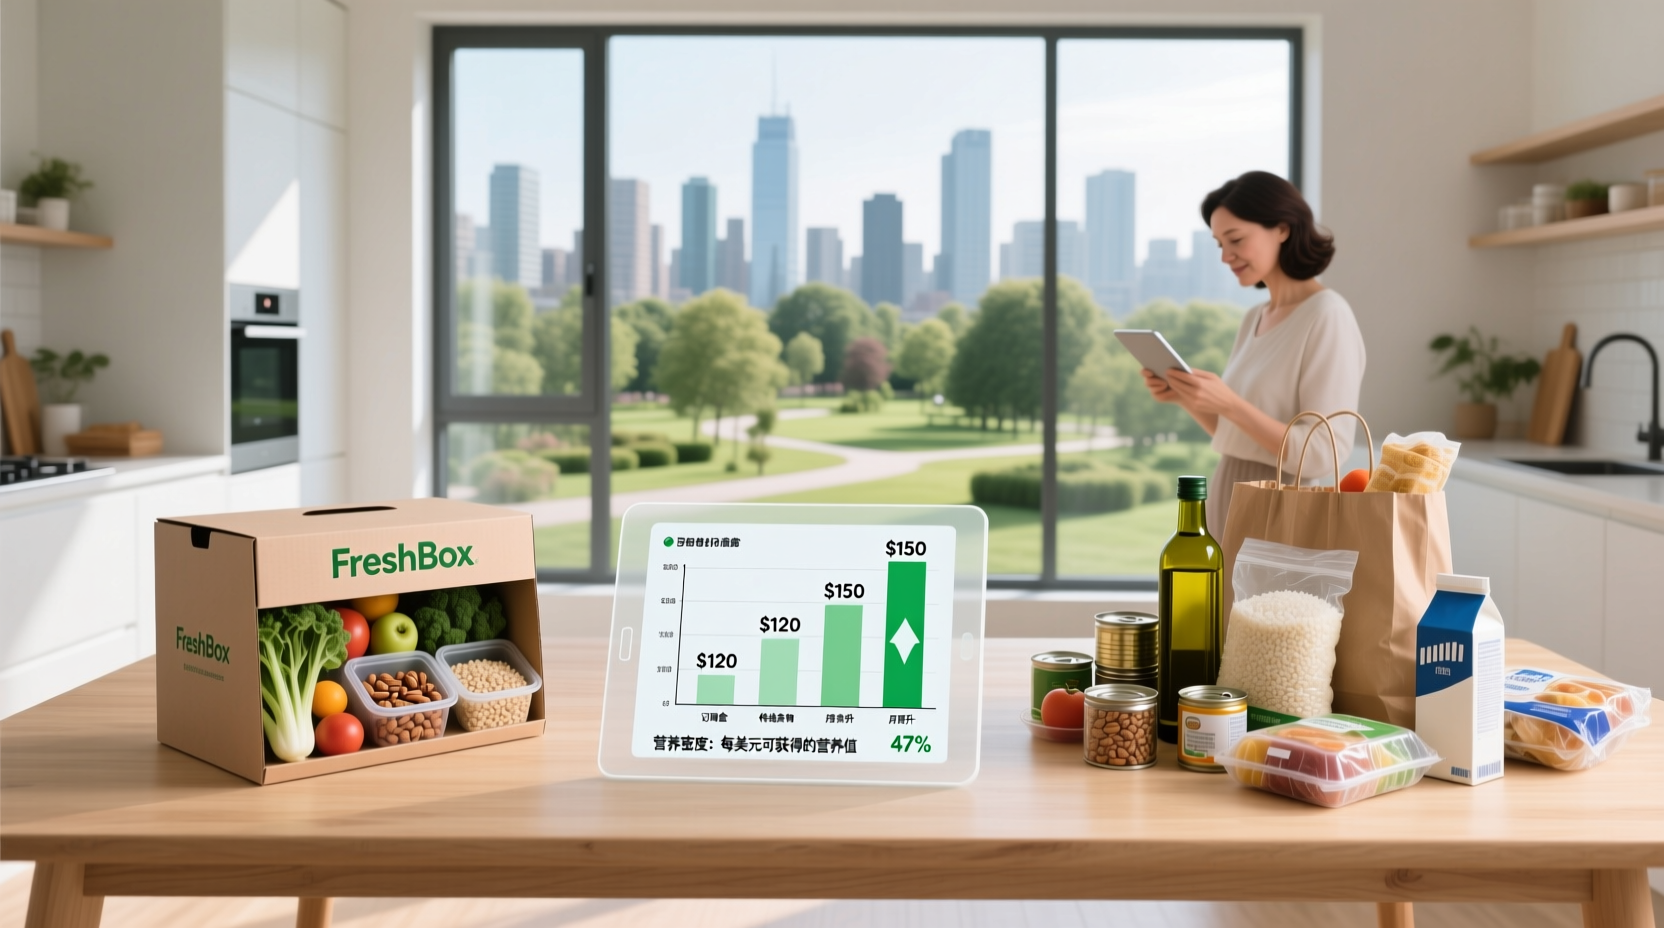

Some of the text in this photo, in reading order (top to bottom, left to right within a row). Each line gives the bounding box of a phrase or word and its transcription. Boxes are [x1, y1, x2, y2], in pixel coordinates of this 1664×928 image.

[885, 540, 927, 557] $150
[332, 541, 475, 578] FreshBox
[824, 582, 865, 600] $150
[759, 615, 801, 633] $120
[176, 626, 230, 664] FreshBox
[696, 652, 738, 670] $120
[890, 735, 932, 753] 47%
